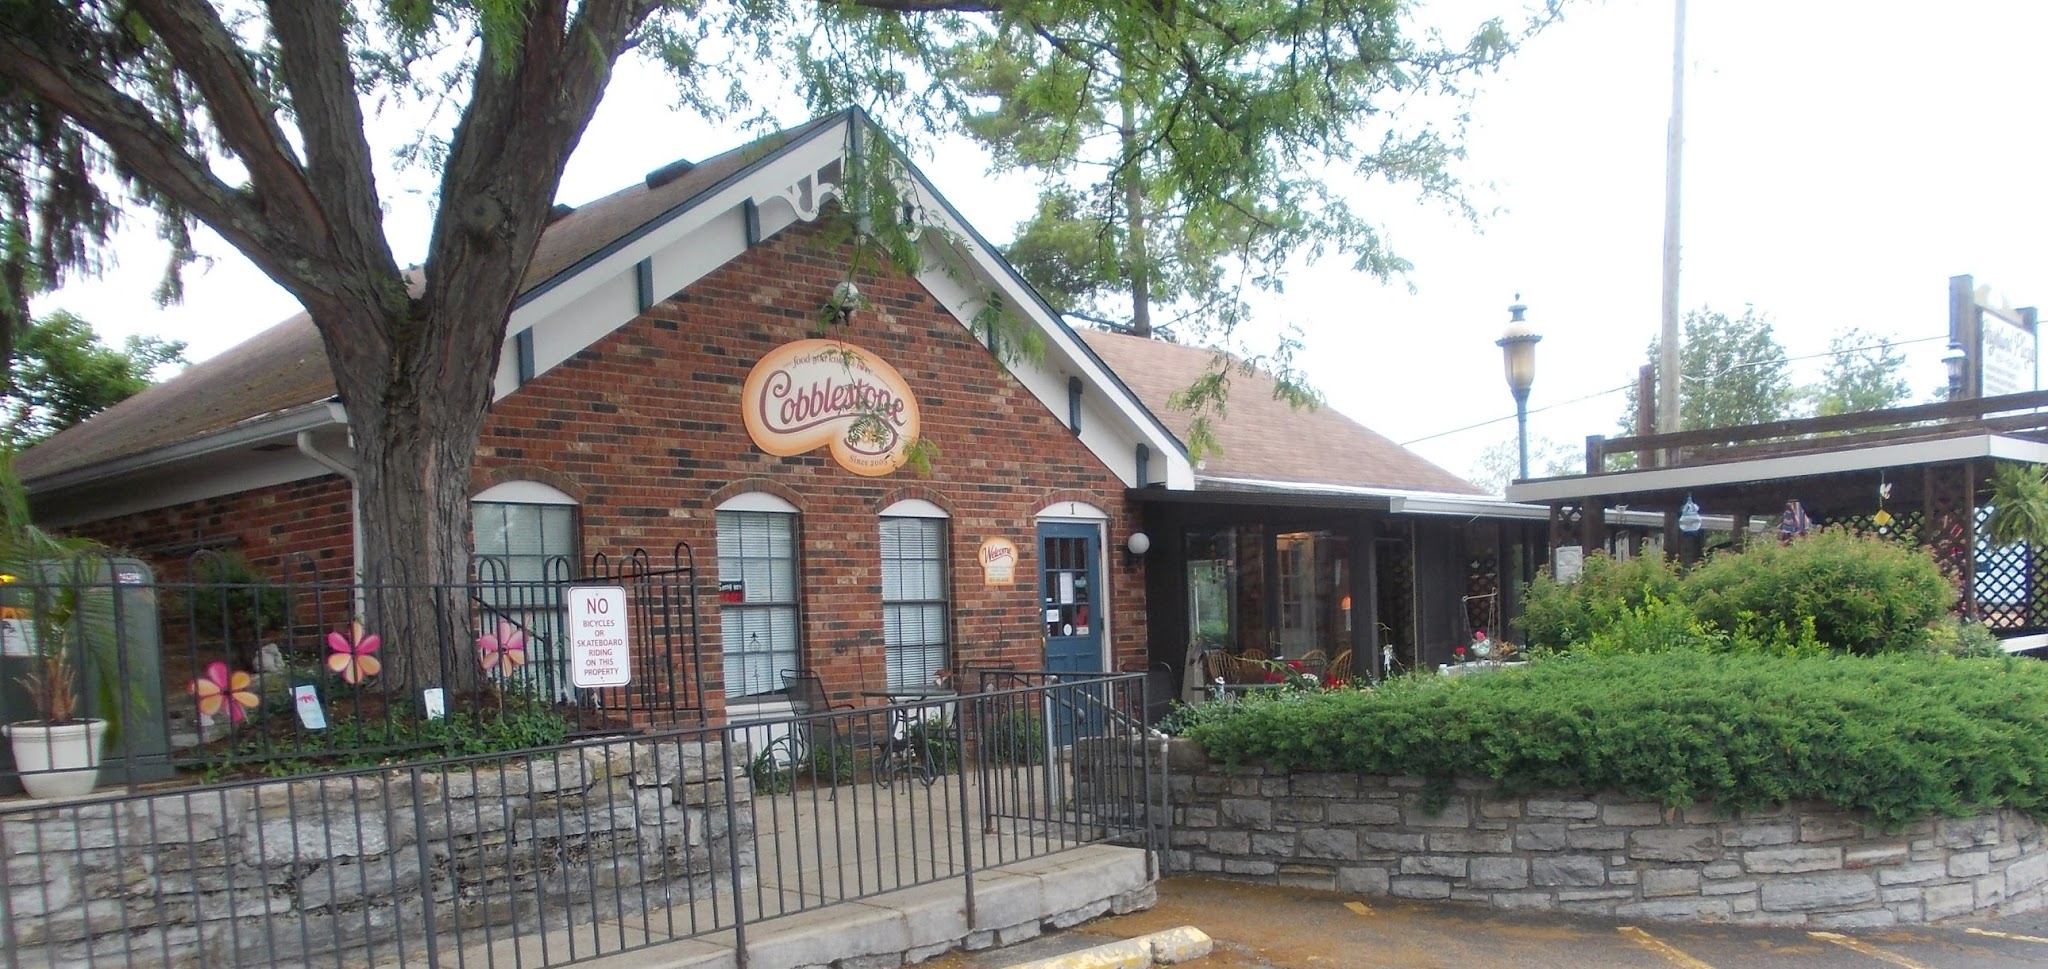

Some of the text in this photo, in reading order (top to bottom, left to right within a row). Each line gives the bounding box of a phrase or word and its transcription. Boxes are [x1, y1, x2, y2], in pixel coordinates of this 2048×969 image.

[793, 353, 810, 368] food
[759, 369, 907, 434] Cobblestone
[849, 454, 868, 466] Since
[1071, 503, 1075, 515] 1
[983, 545, 1012, 564] Welcome
[586, 598, 608, 614] NO
[577, 639, 622, 647] SKATEBOARD
[599, 658, 613, 666] THIS
[584, 668, 619, 676] PROPERTY
